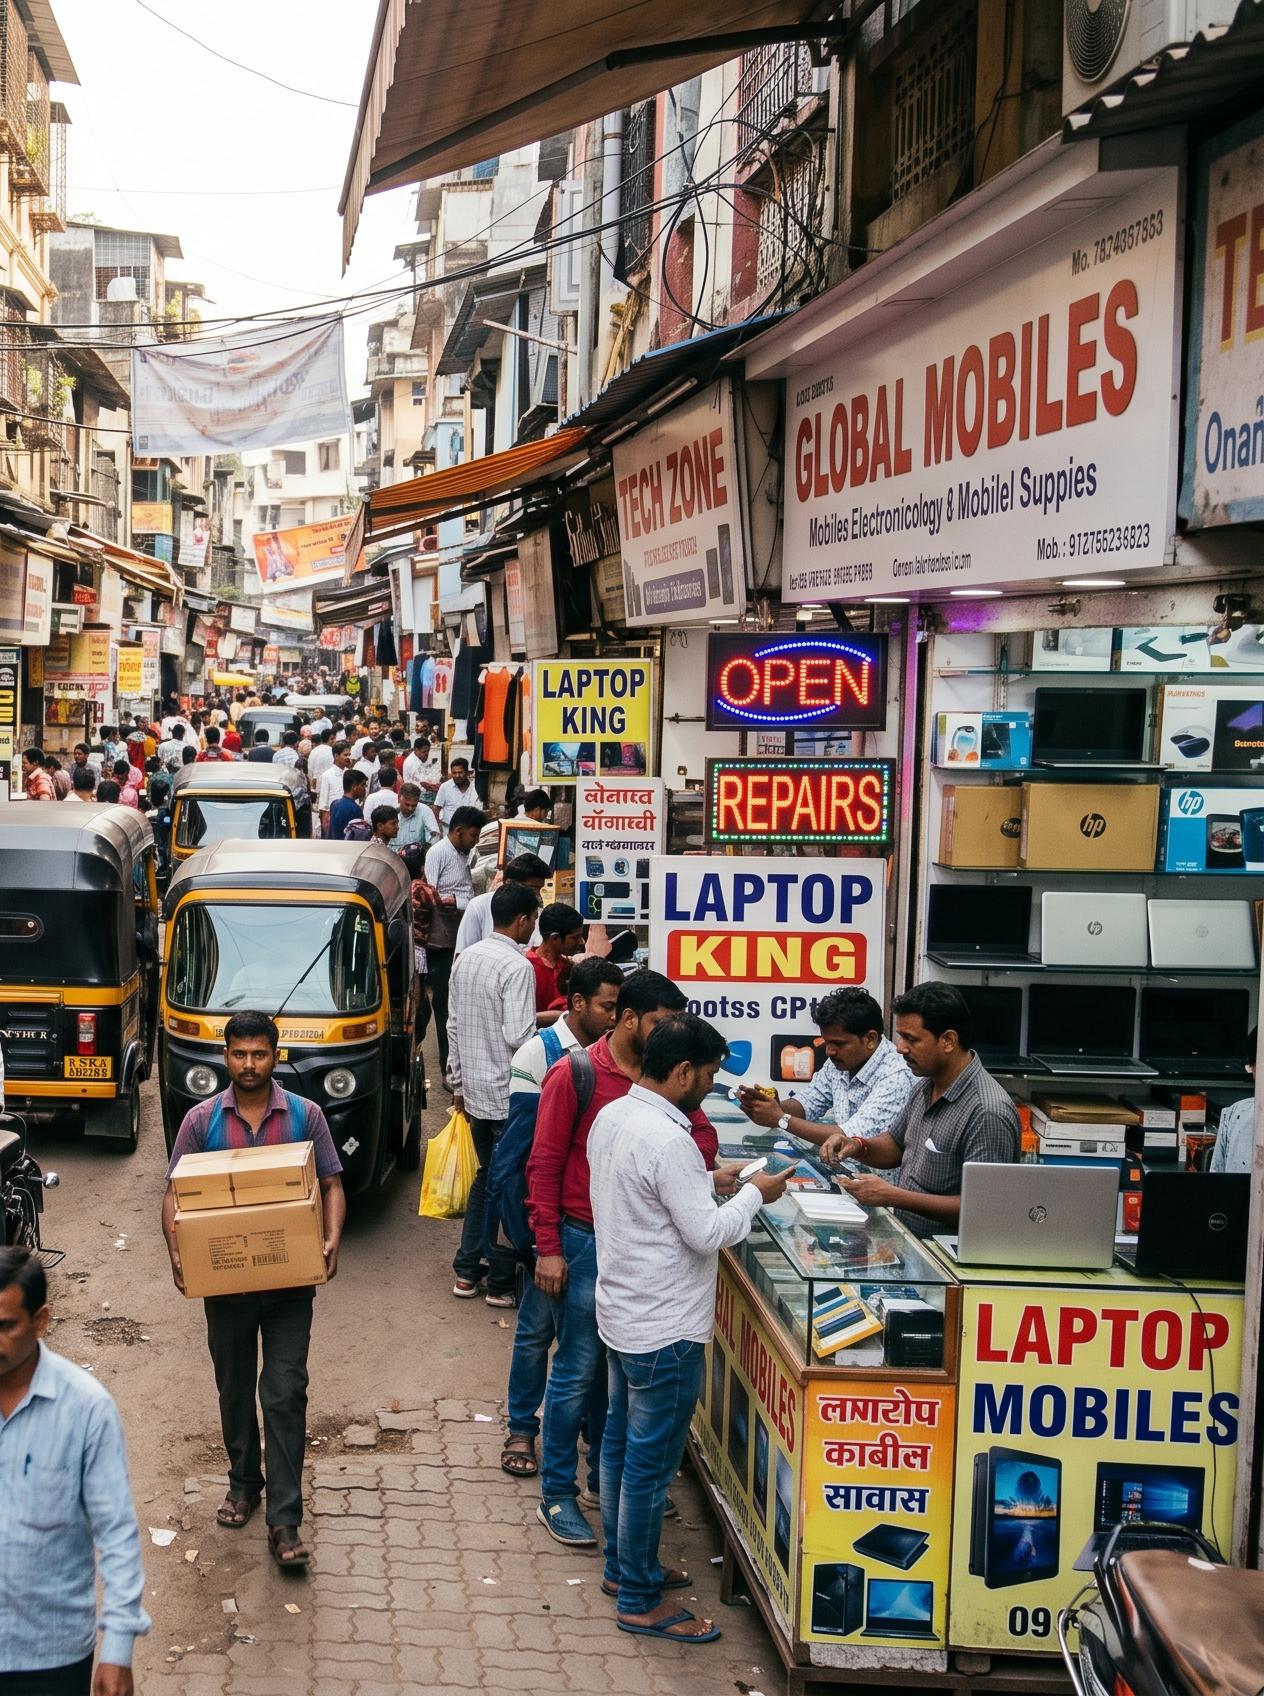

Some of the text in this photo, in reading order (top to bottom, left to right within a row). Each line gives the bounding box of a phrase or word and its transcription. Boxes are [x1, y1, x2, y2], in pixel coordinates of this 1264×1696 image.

[1072, 249, 1090, 276] Mo.
[796, 279, 1139, 503] GLOBAL MOBILES
[619, 427, 728, 541] TECH ZONE
[809, 512, 848, 548] Mobiles
[946, 487, 955, 522] &
[541, 668, 645, 699] LAPTOP
[720, 658, 869, 706] OPEN
[562, 705, 626, 735] KING
[718, 775, 881, 831] REPAIRS
[1080, 813, 1107, 838] hp
[1177, 790, 1204, 815] hp
[664, 872, 874, 925] LAPTOP
[679, 935, 857, 979] KING
[975, 1303, 1230, 1372] LAPTOP
[740, 1311, 796, 1454] MOBILES
[972, 1383, 1241, 1447] MOBILES
